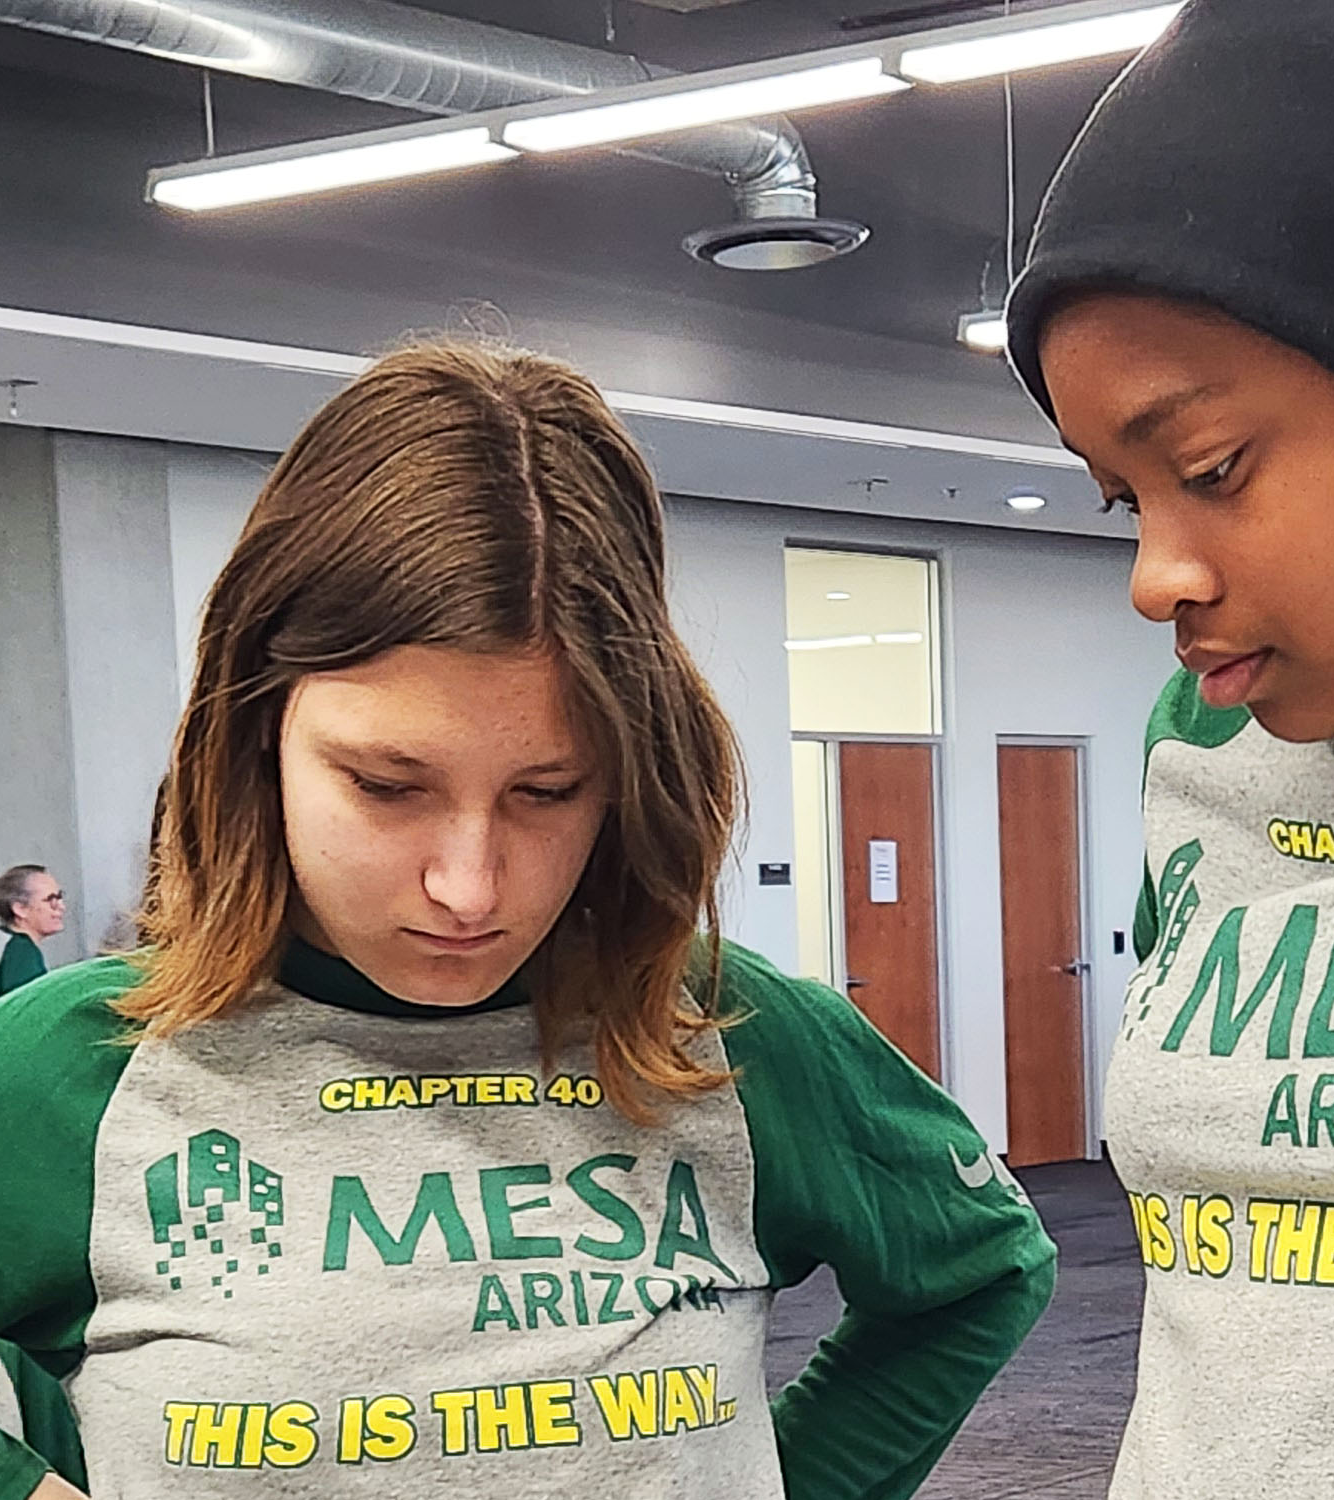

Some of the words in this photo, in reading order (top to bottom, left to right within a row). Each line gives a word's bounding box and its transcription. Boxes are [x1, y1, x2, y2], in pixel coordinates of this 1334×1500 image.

[320, 1076, 538, 1112] CHAPTER
[545, 1074, 602, 1106] 40
[323, 1153, 738, 1285] MESA
[1127, 1190, 1176, 1272] IS
[1182, 1193, 1234, 1279] IS
[164, 1400, 319, 1469] THIS
[337, 1394, 416, 1464] IS
[432, 1379, 582, 1456] THE
